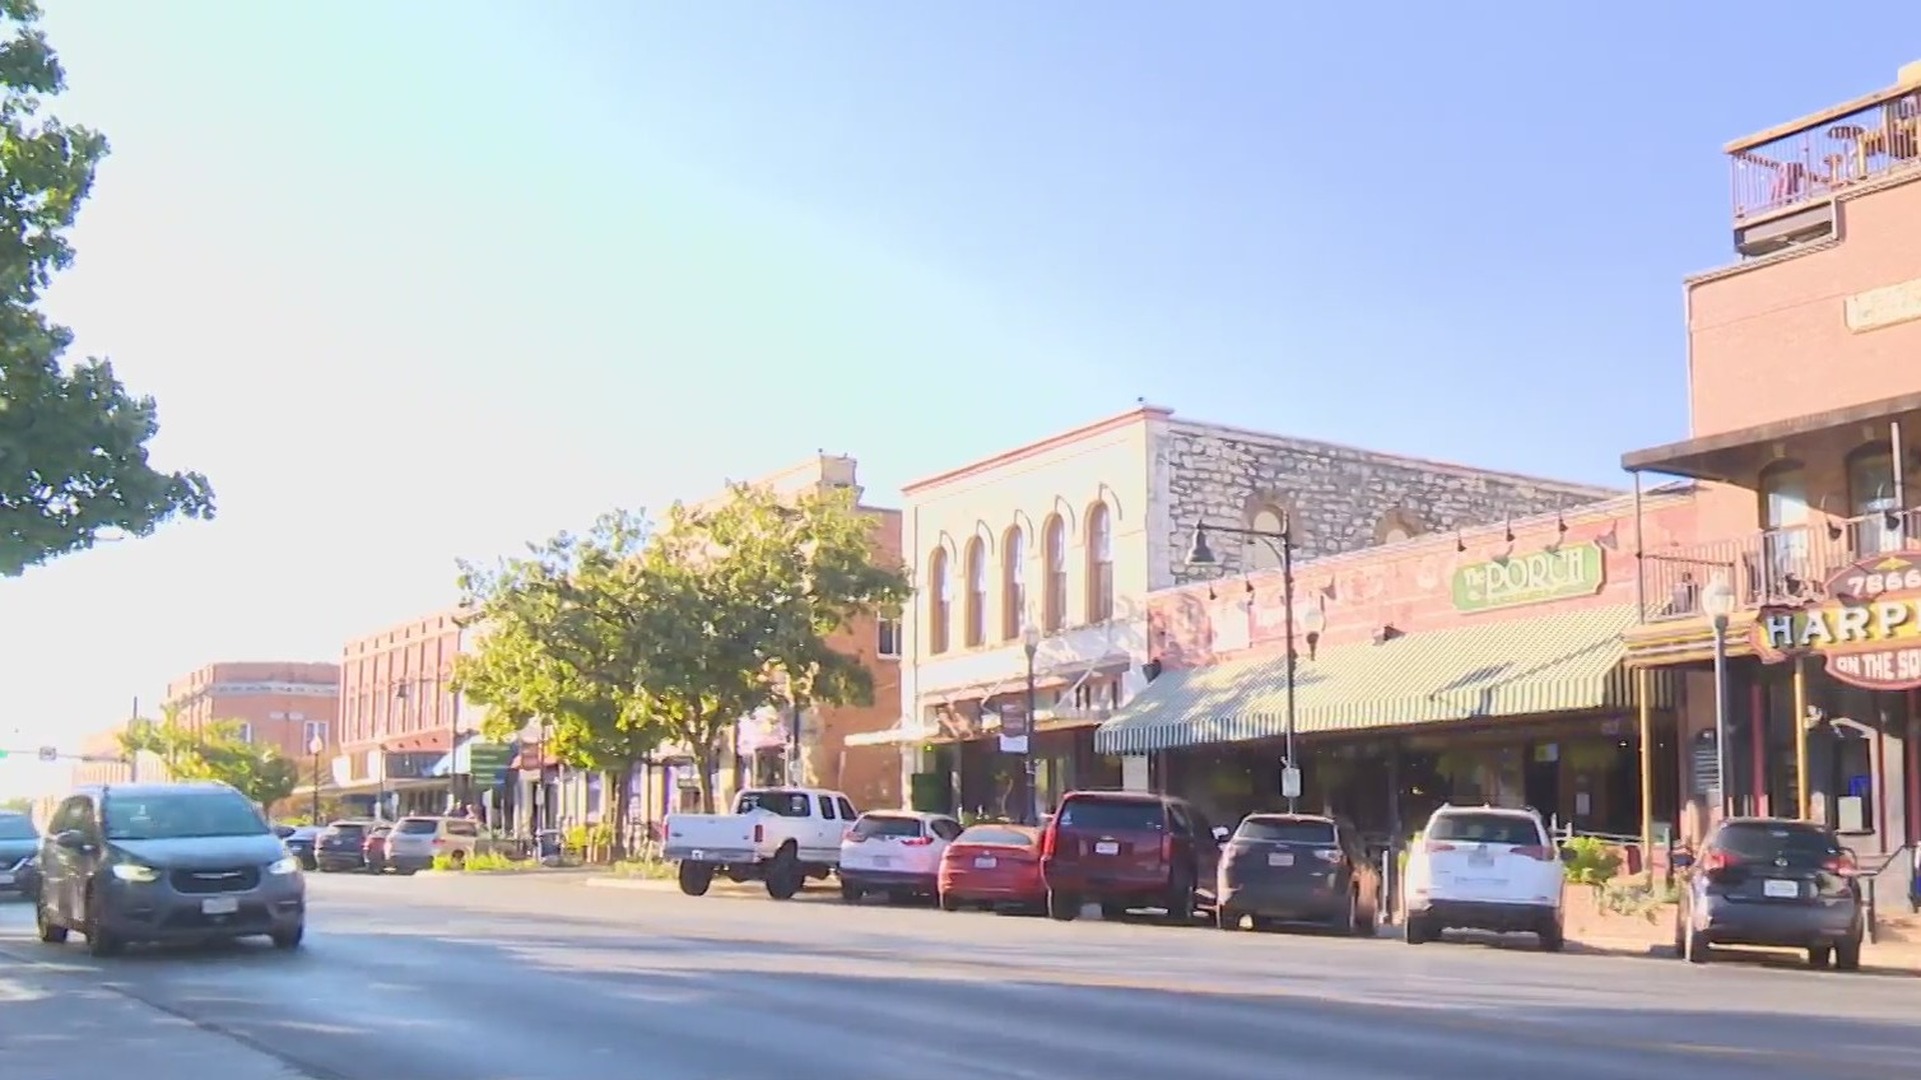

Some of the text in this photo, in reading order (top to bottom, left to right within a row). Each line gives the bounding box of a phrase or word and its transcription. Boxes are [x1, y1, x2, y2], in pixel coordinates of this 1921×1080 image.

[1486, 547, 1585, 600] PORCH
[1767, 600, 1921, 647] HARP
[1836, 656, 1860, 675] ON
[1862, 651, 1895, 680] THE
